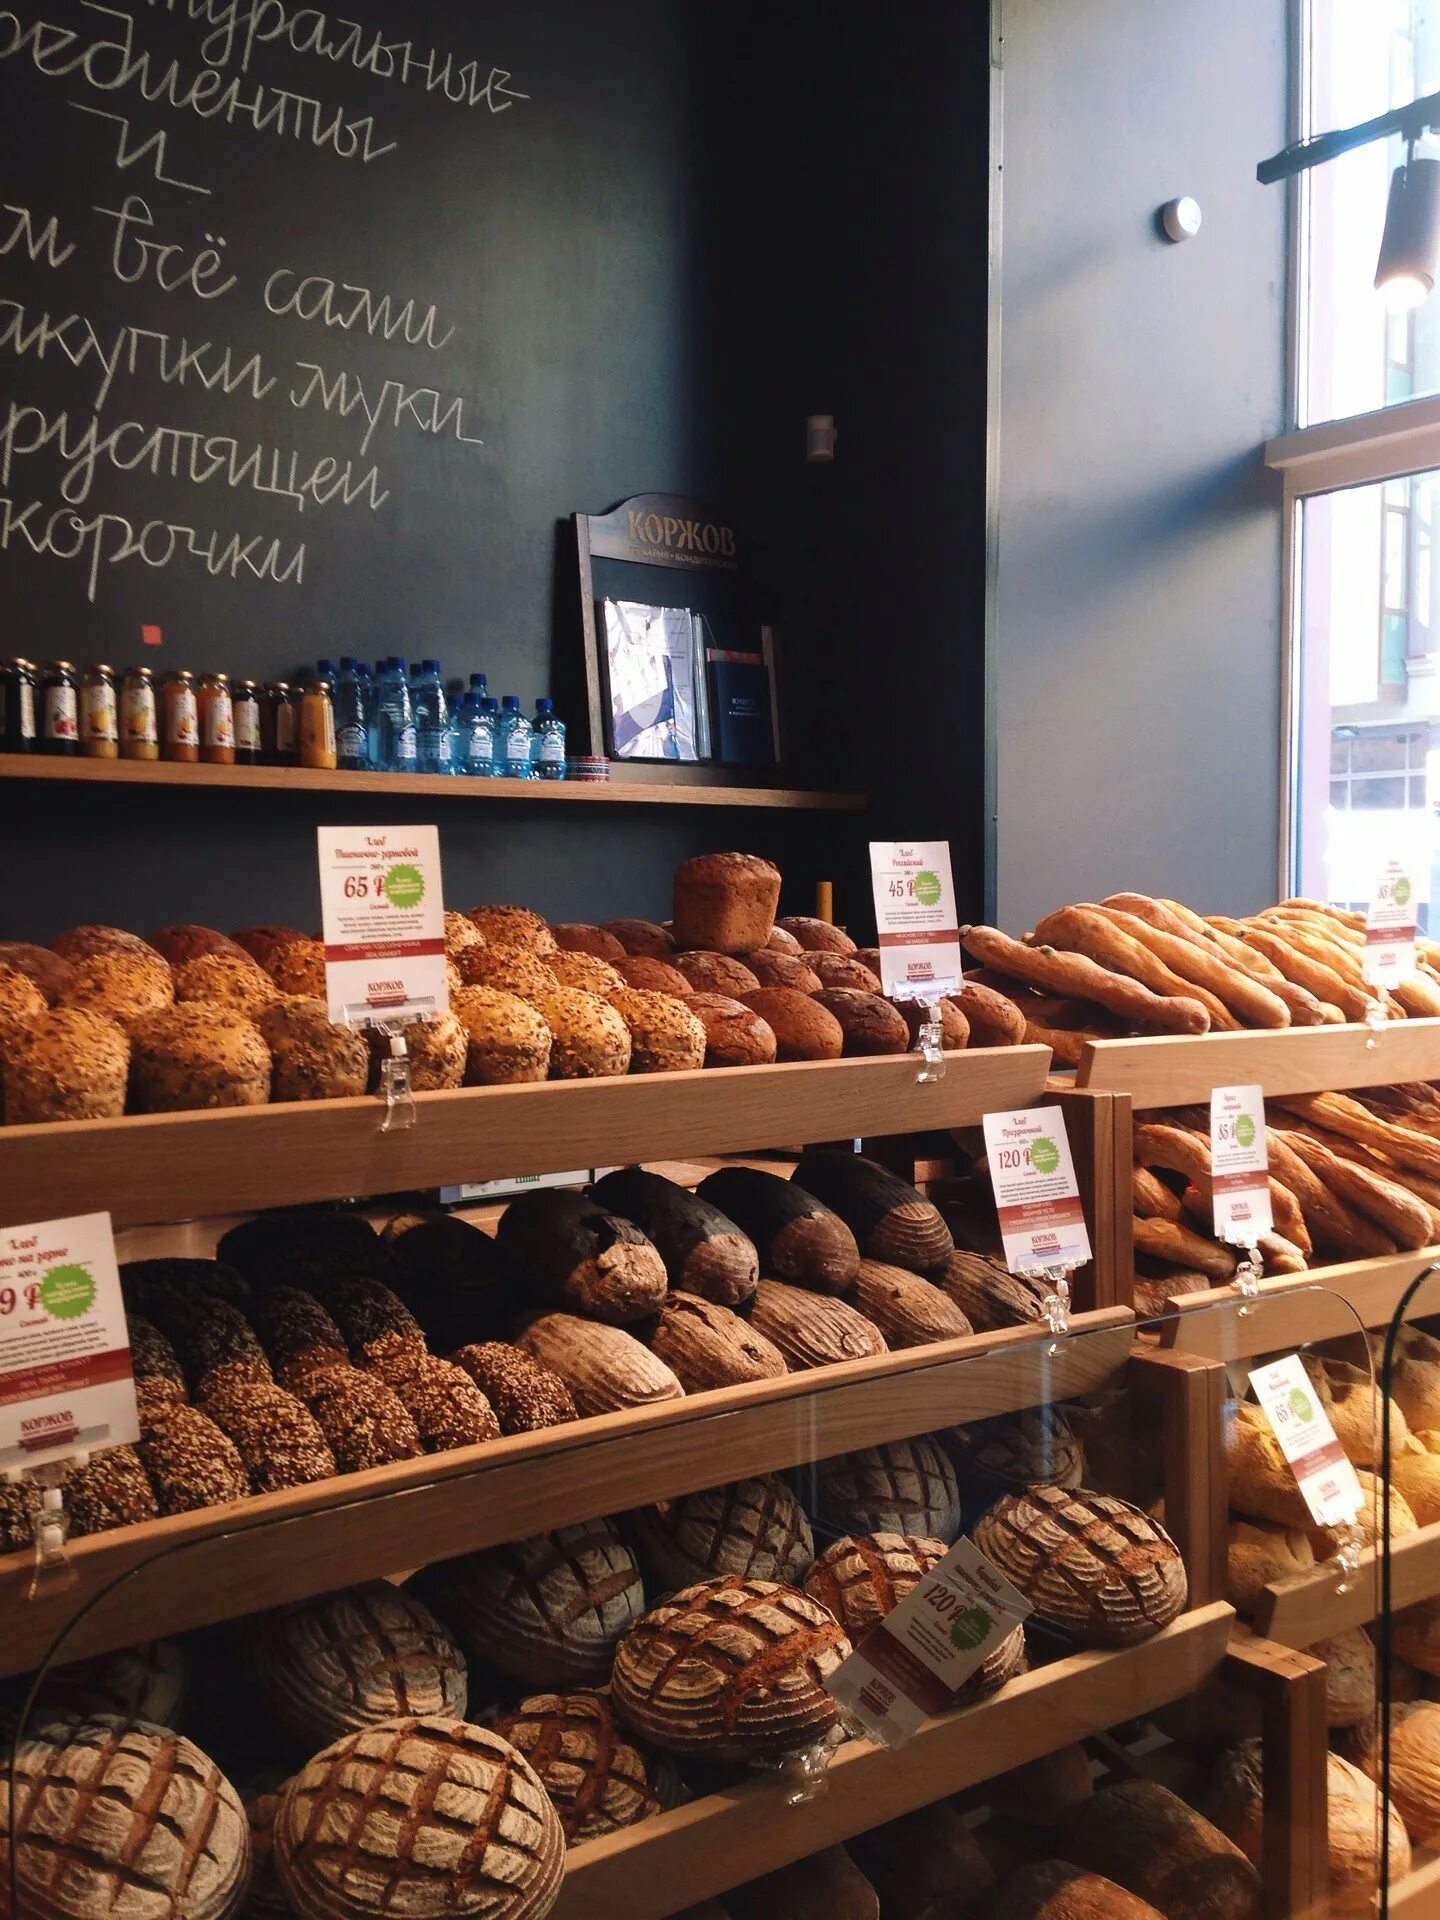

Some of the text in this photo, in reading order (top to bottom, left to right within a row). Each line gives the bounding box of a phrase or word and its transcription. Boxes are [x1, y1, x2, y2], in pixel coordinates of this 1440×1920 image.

[91, 195, 238, 299] всё
[264, 269, 456, 349] сами
[290, 362, 485, 456] муки
[627, 509, 737, 556] КОРЖОВ
[0, 498, 306, 604] корочки
[344, 875, 368, 898] 65
[888, 880, 904, 898] 45
[907, 962, 932, 971] КОРЖОВ
[367, 981, 404, 992] КОРЖОВ
[1218, 1122, 1229, 1141] 85
[998, 1149, 1021, 1170] 120
[0, 1287, 17, 1315] 9
[20, 1410, 74, 1432] КОРЖОВ
[922, 1583, 956, 1613] 120
